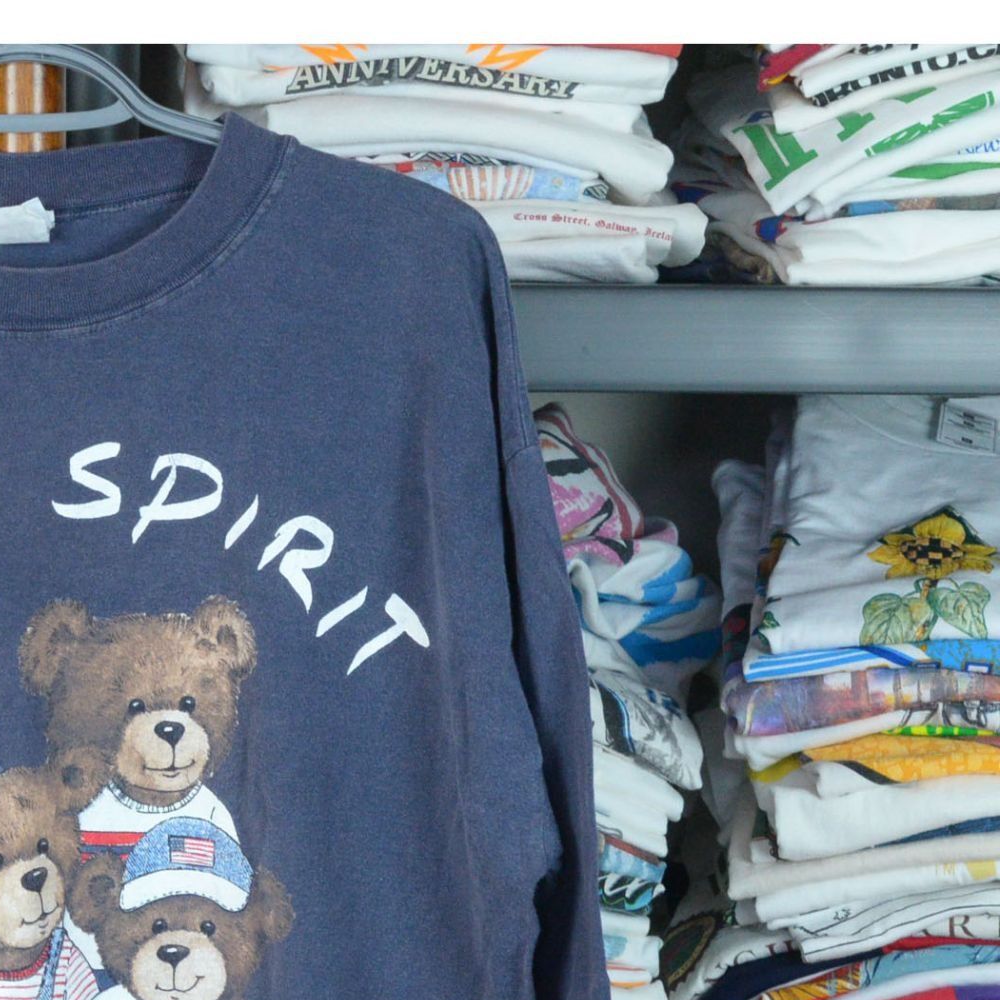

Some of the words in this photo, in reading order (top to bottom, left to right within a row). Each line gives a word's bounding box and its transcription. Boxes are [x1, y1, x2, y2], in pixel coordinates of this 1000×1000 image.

[286, 55, 582, 100] ANNIVERSARY
[513, 212, 547, 221] Cross
[551, 212, 590, 227] Street,
[52, 442, 430, 675] SPIRIT
